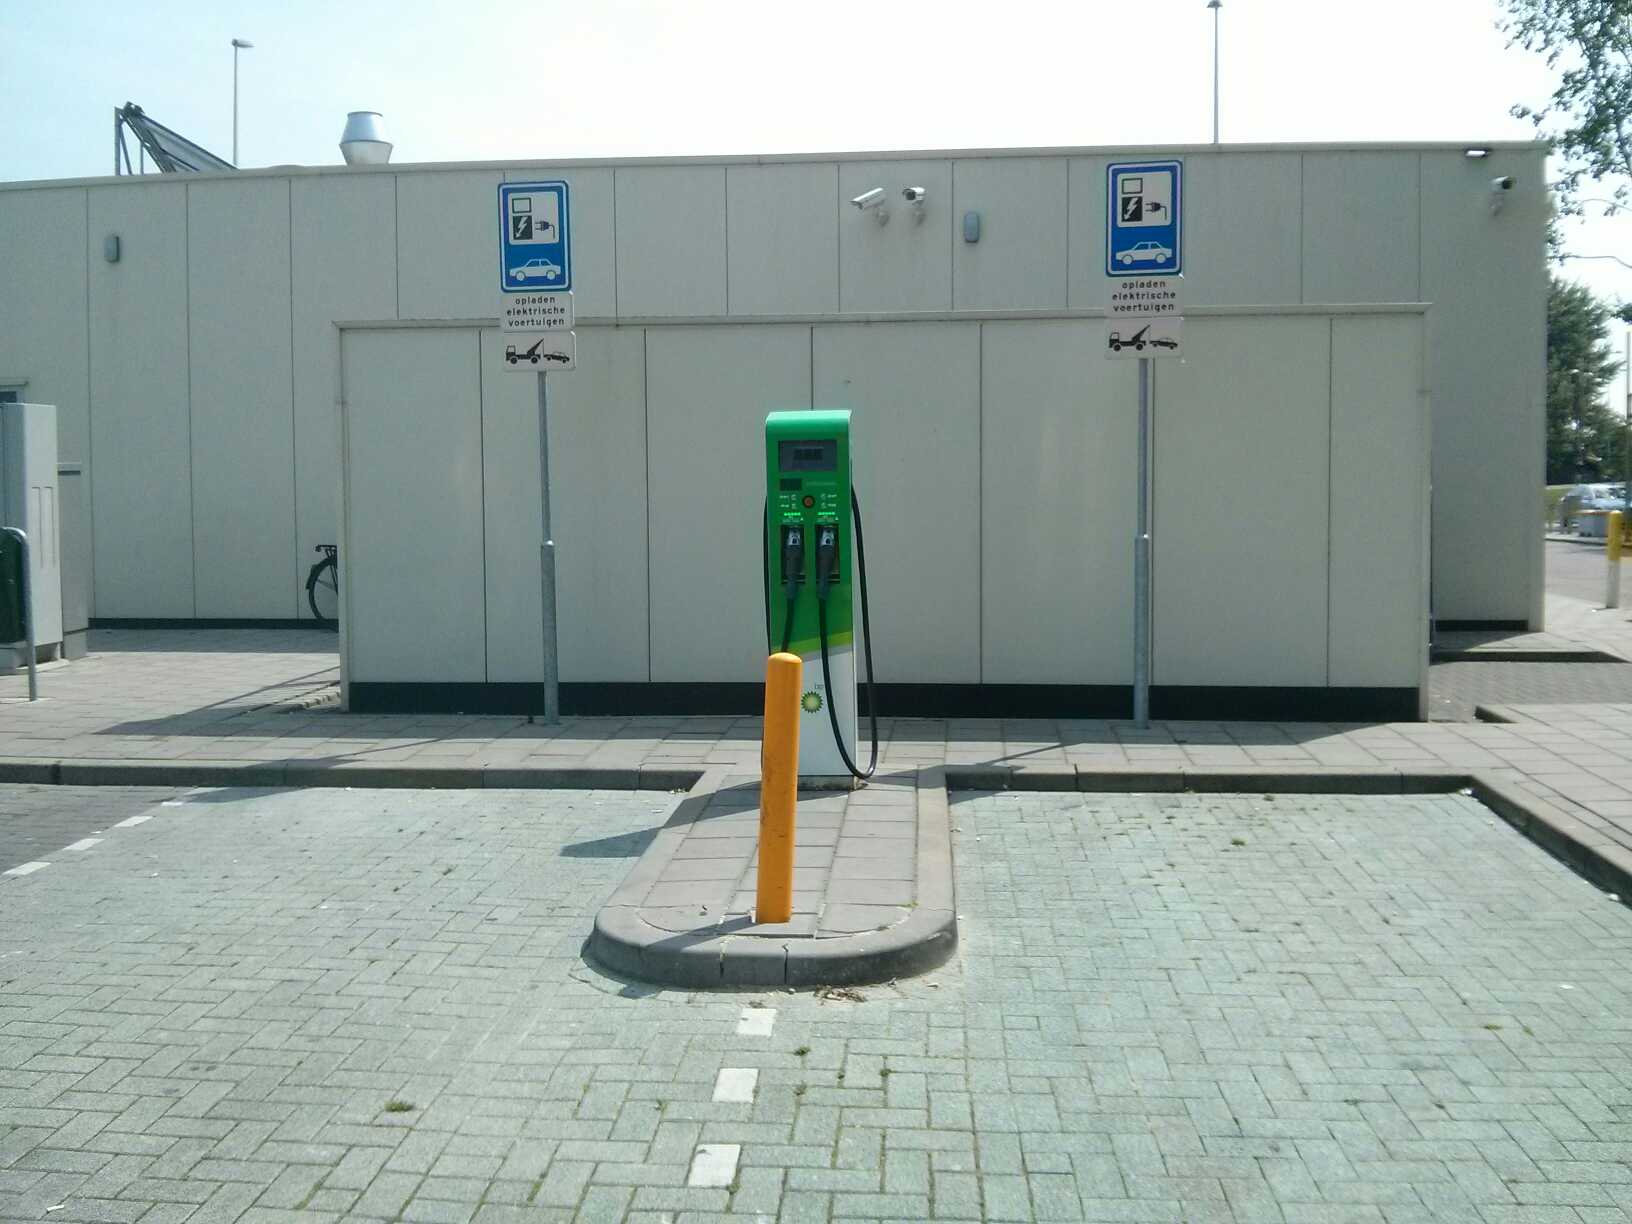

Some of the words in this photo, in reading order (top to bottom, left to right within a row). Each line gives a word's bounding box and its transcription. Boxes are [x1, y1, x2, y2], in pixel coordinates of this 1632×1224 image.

[1122, 280, 1166, 289] opladen
[1112, 291, 1176, 300] elektrische
[515, 296, 555, 305] opladen
[506, 306, 565, 316] elektrische
[1113, 303, 1174, 312] voertuigen
[508, 318, 565, 327] voertuigen
